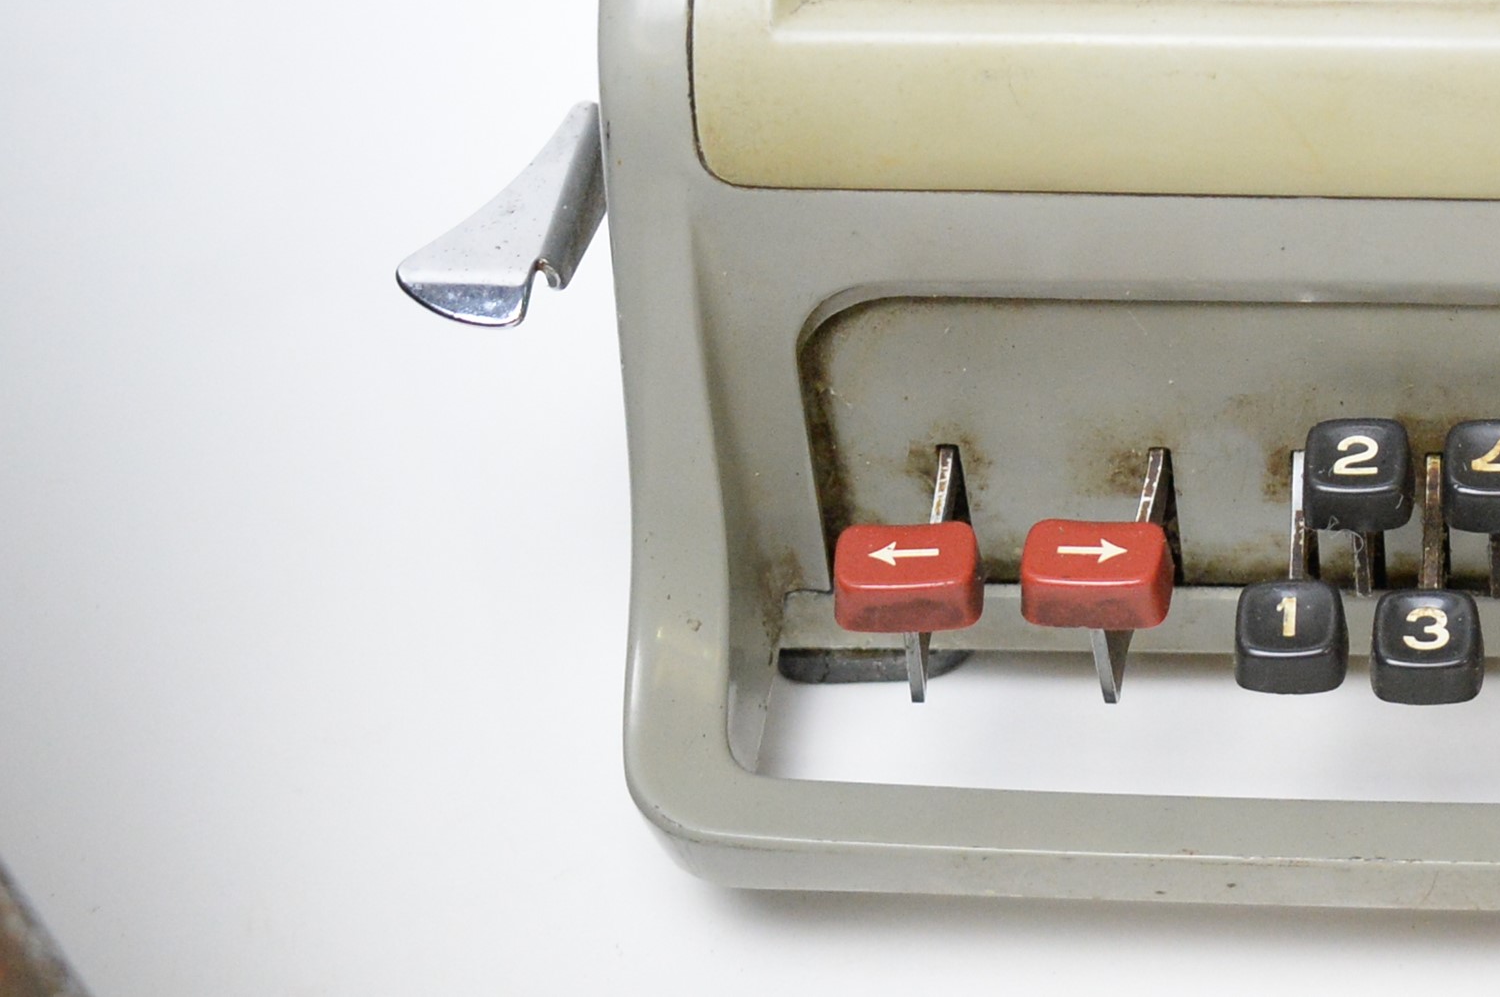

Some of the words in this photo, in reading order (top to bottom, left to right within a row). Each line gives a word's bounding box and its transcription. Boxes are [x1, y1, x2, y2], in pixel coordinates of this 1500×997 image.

[1333, 435, 1379, 475] 2
[1275, 596, 1297, 637] 1
[1402, 606, 1450, 650] 3
